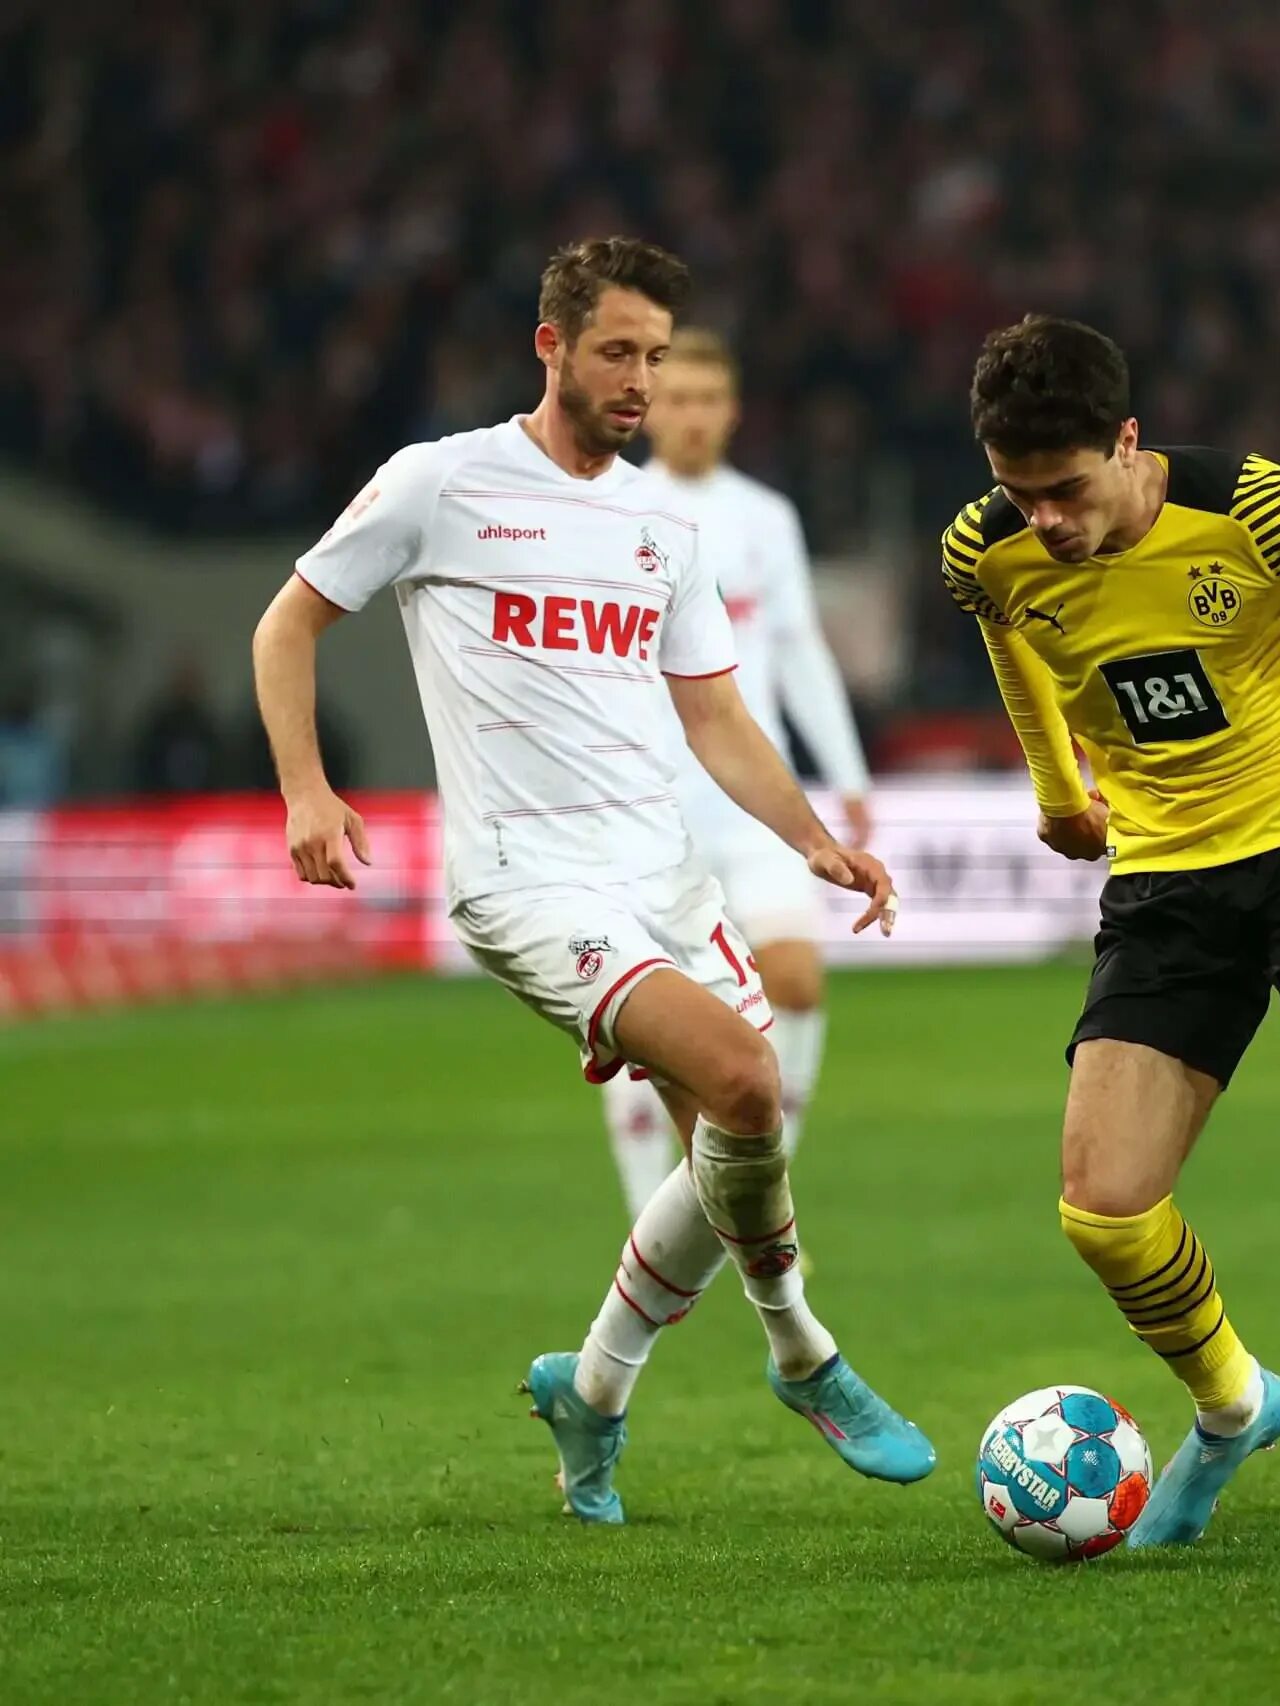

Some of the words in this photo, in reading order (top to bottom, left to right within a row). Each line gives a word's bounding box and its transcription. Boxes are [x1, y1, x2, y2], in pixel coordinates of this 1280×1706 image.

[478, 525, 546, 541] uhlsport
[1194, 581, 1237, 616] BVB
[1211, 611, 1227, 623] 09
[1117, 673, 1208, 724] 1&1
[710, 920, 757, 988] 1
[989, 1433, 1060, 1508] DERBYSTAR
